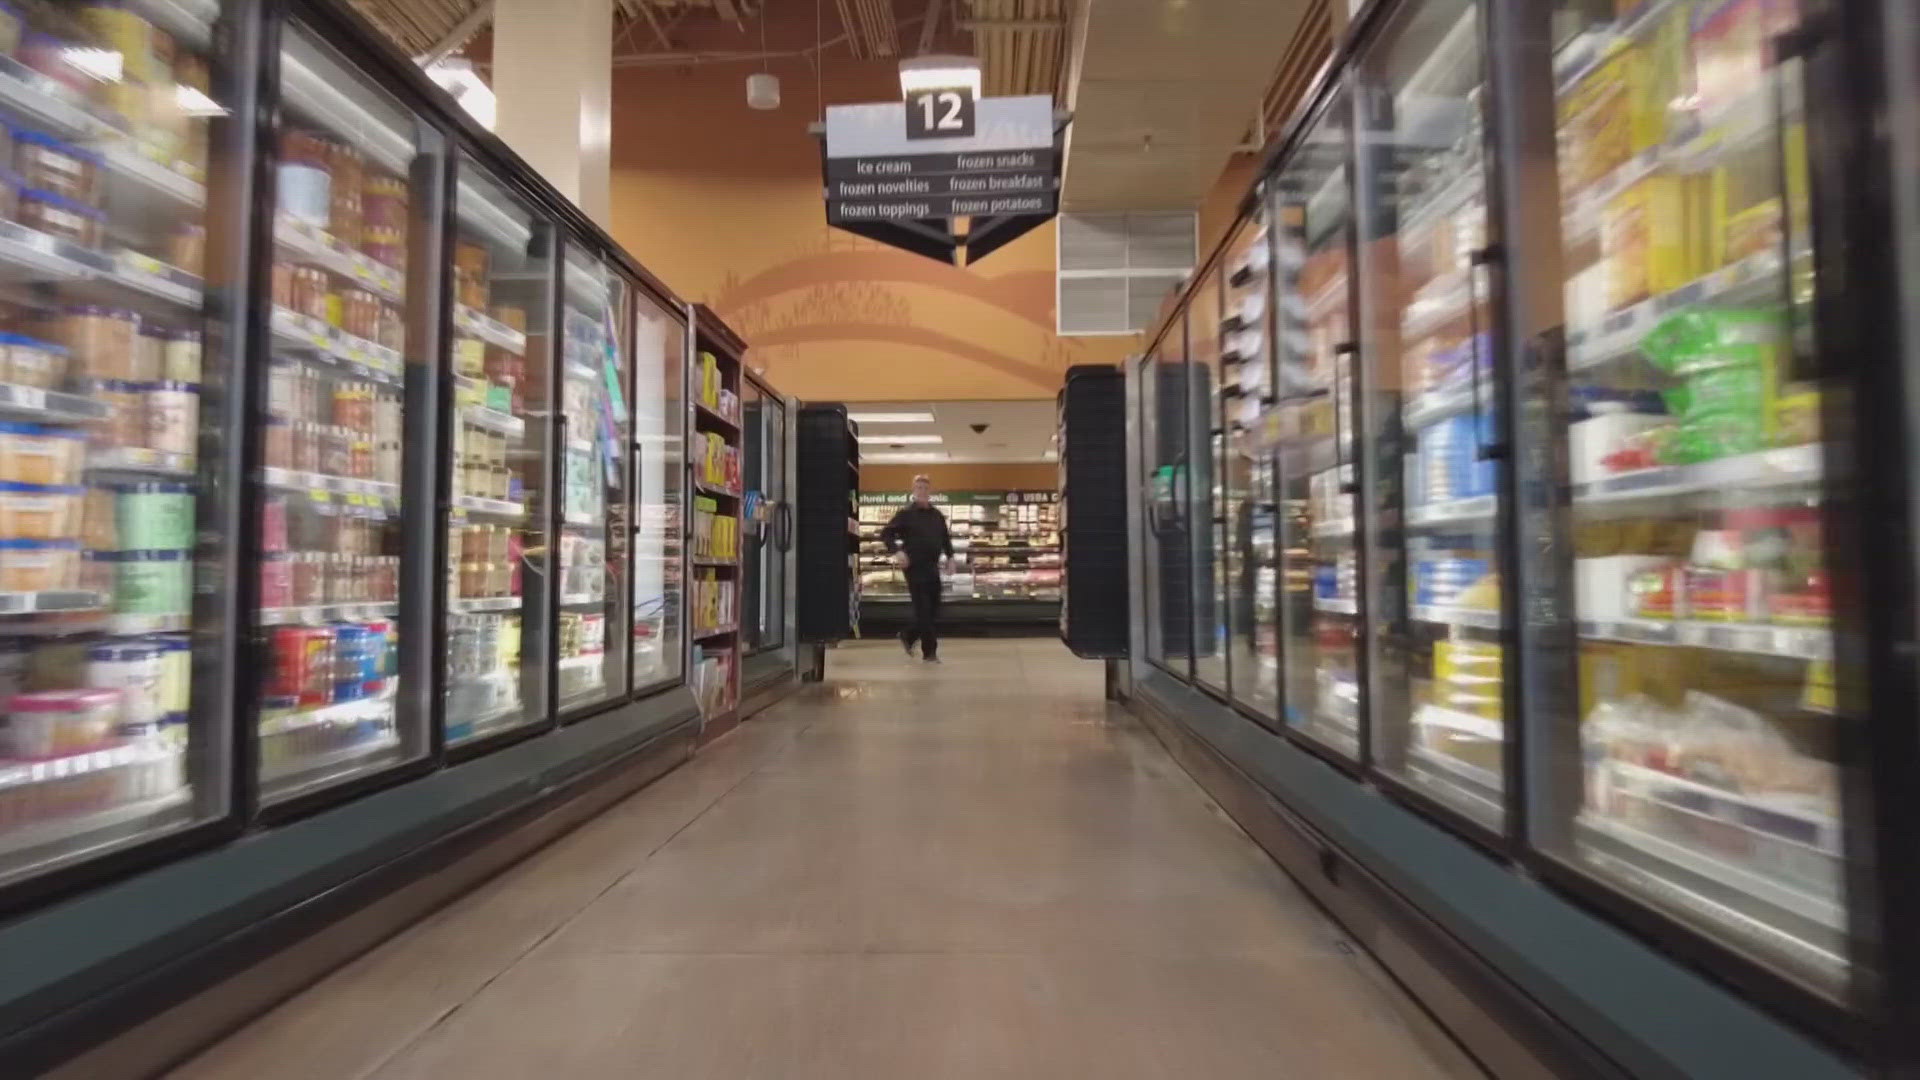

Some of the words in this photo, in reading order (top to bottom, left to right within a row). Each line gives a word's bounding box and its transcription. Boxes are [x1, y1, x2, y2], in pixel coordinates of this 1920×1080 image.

[917, 92, 964, 131] 12
[857, 159, 874, 175] ice
[876, 161, 912, 174] cream
[957, 155, 994, 169] frozen
[996, 152, 1035, 168] snacks
[840, 181, 875, 196] frozen
[878, 178, 930, 194] novelties
[950, 176, 987, 191] frozen
[989, 174, 1043, 189] breakfast
[840, 202, 876, 217] frozen
[879, 201, 930, 219] toppings
[952, 198, 988, 213] frozen
[991, 198, 1042, 214] potatoes
